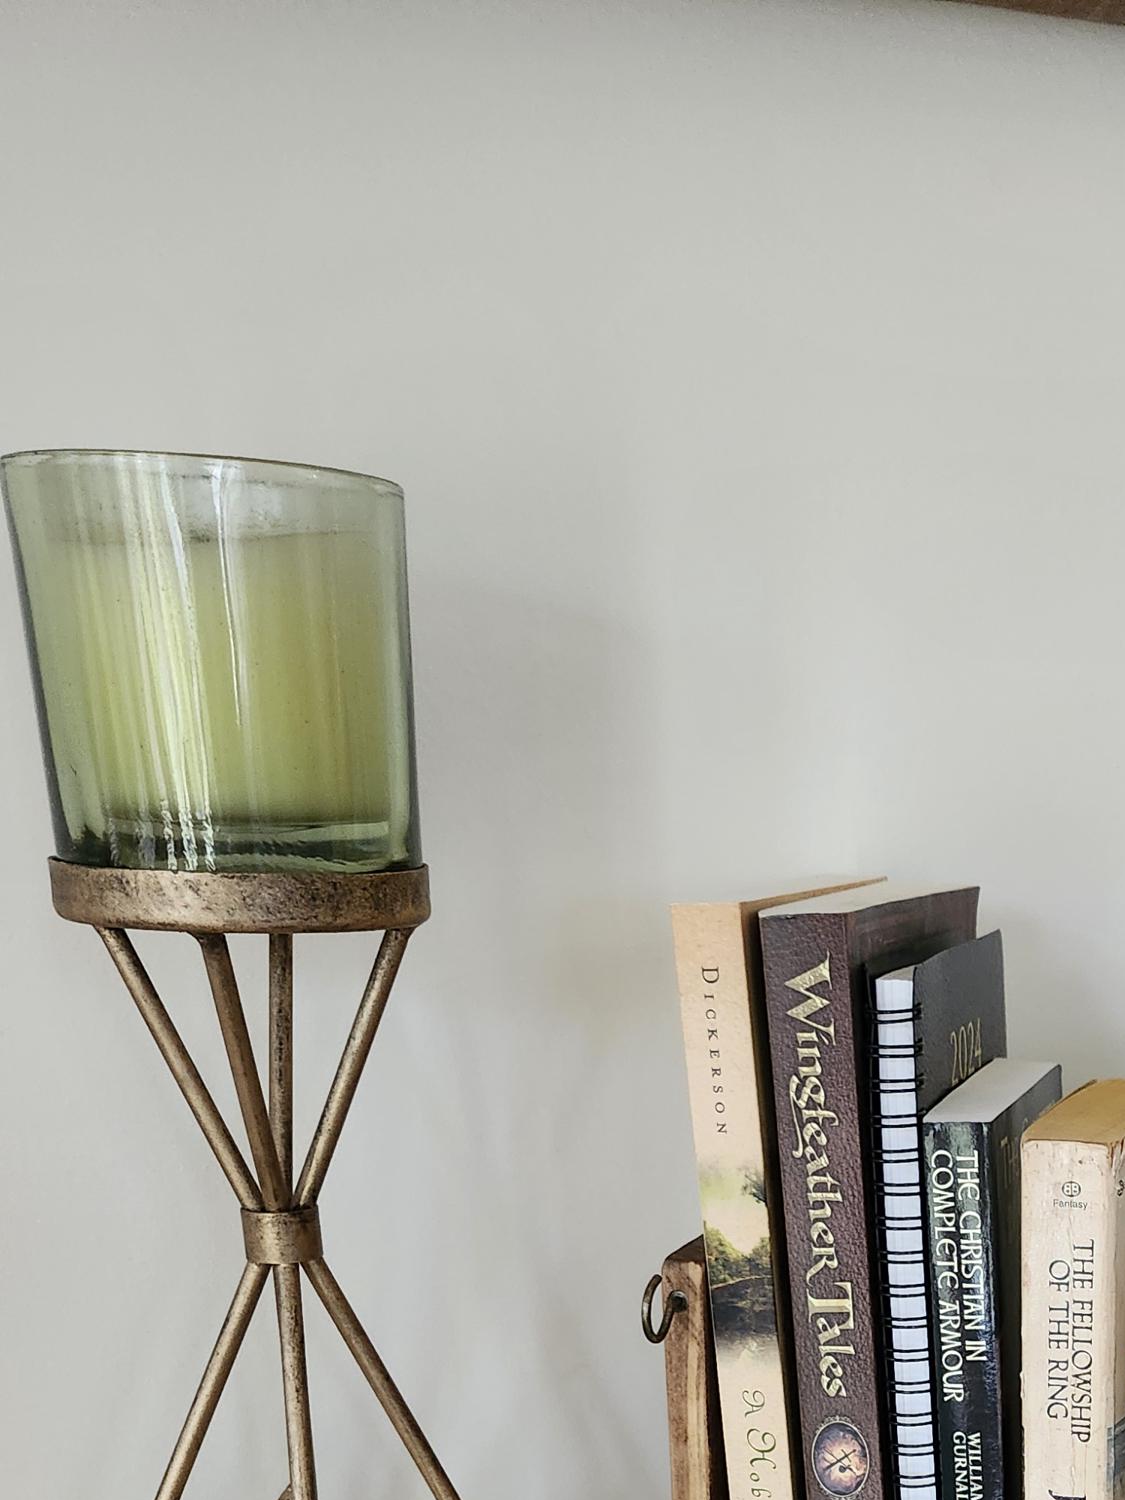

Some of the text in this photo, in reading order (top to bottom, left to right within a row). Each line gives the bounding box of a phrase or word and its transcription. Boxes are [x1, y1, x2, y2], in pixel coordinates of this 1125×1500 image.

[701, 966, 728, 1136] DICKERSON
[950, 1017, 982, 1087] 2024
[931, 1149, 965, 1402] COMPLETE ARMOUR
[956, 1150, 987, 1362] THE CHRISTIAN IN
[1053, 1199, 1088, 1211] Fantasy
[742, 1389, 766, 1418] A
[806, 1281, 856, 1398] Tales
[1047, 1259, 1071, 1420] OF THE RING
[1071, 1239, 1094, 1443] THE FELLOWSHIP
